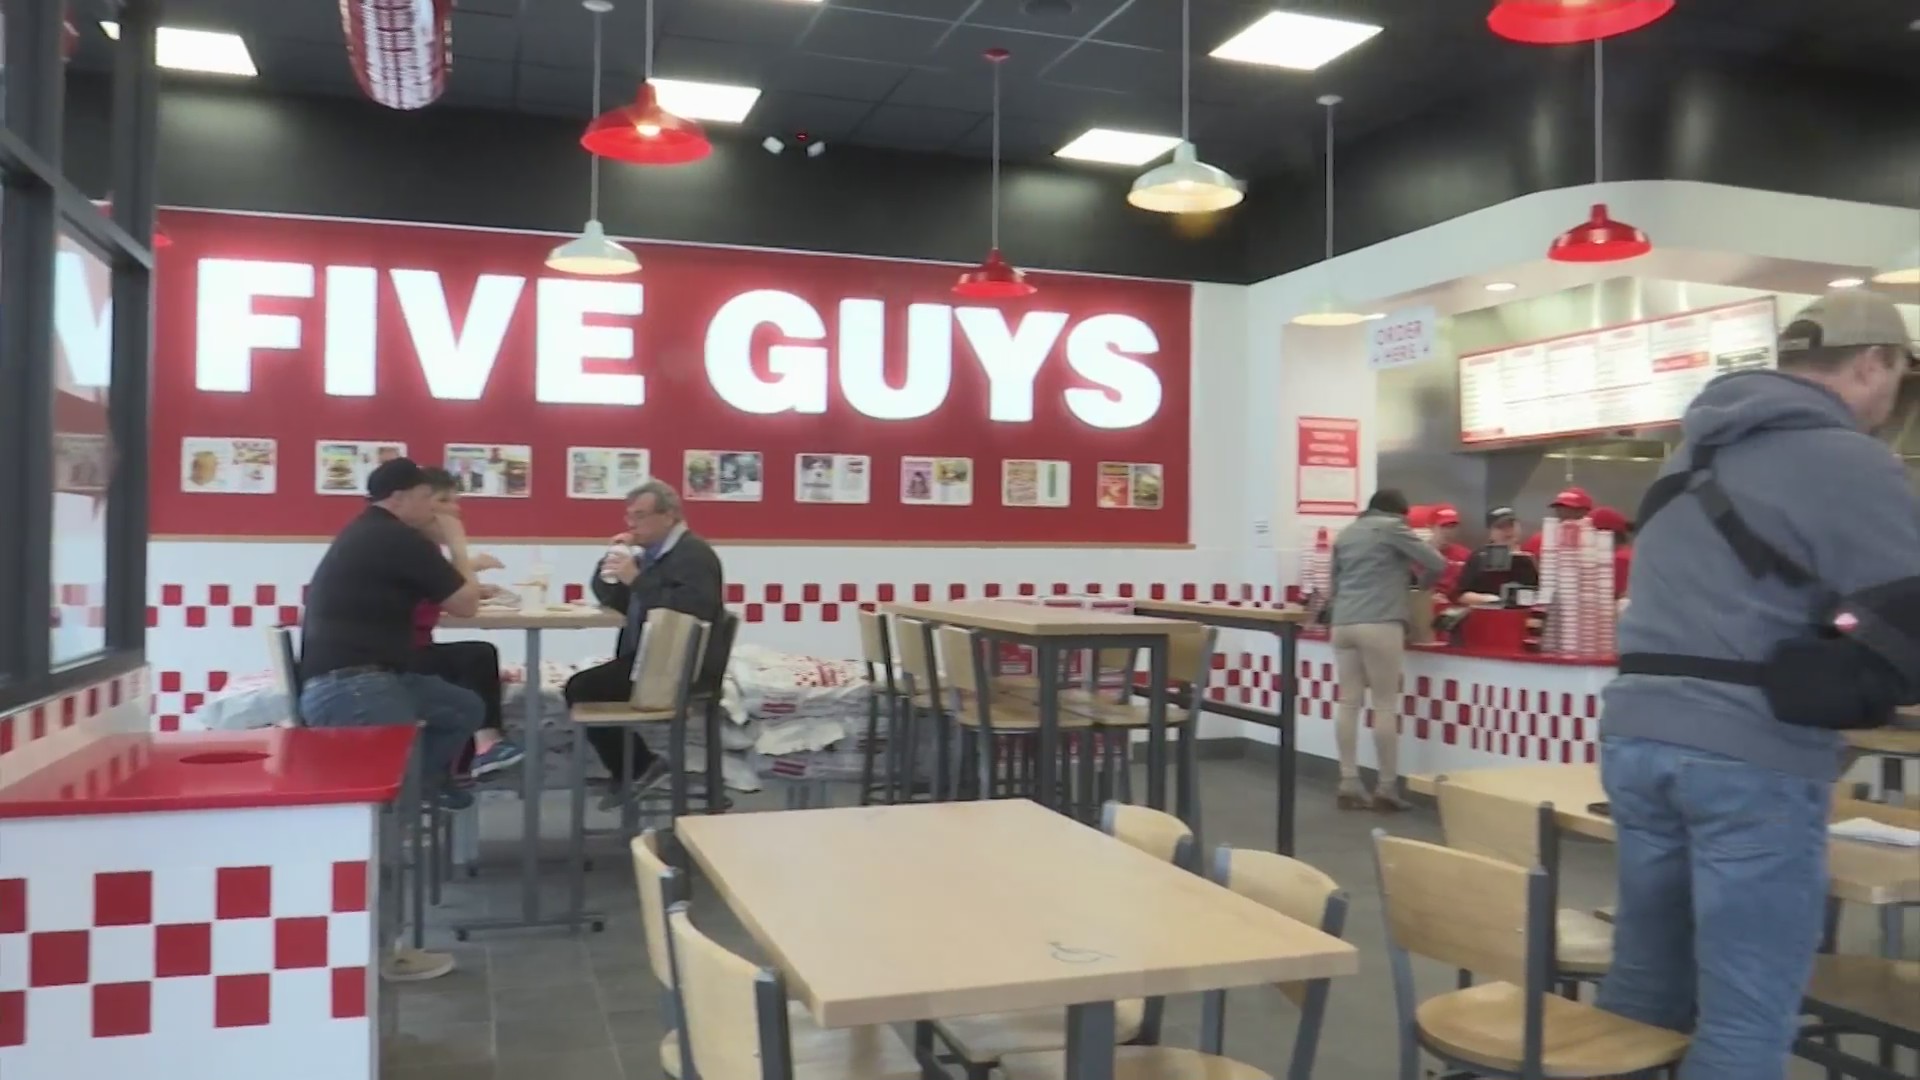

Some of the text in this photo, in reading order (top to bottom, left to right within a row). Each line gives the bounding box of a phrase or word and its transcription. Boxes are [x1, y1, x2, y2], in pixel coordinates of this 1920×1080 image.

[195, 258, 645, 405] FIVE
[704, 289, 1163, 429] GUYS
[1376, 320, 1422, 346] ORDER
[1384, 344, 1418, 363] HERE
